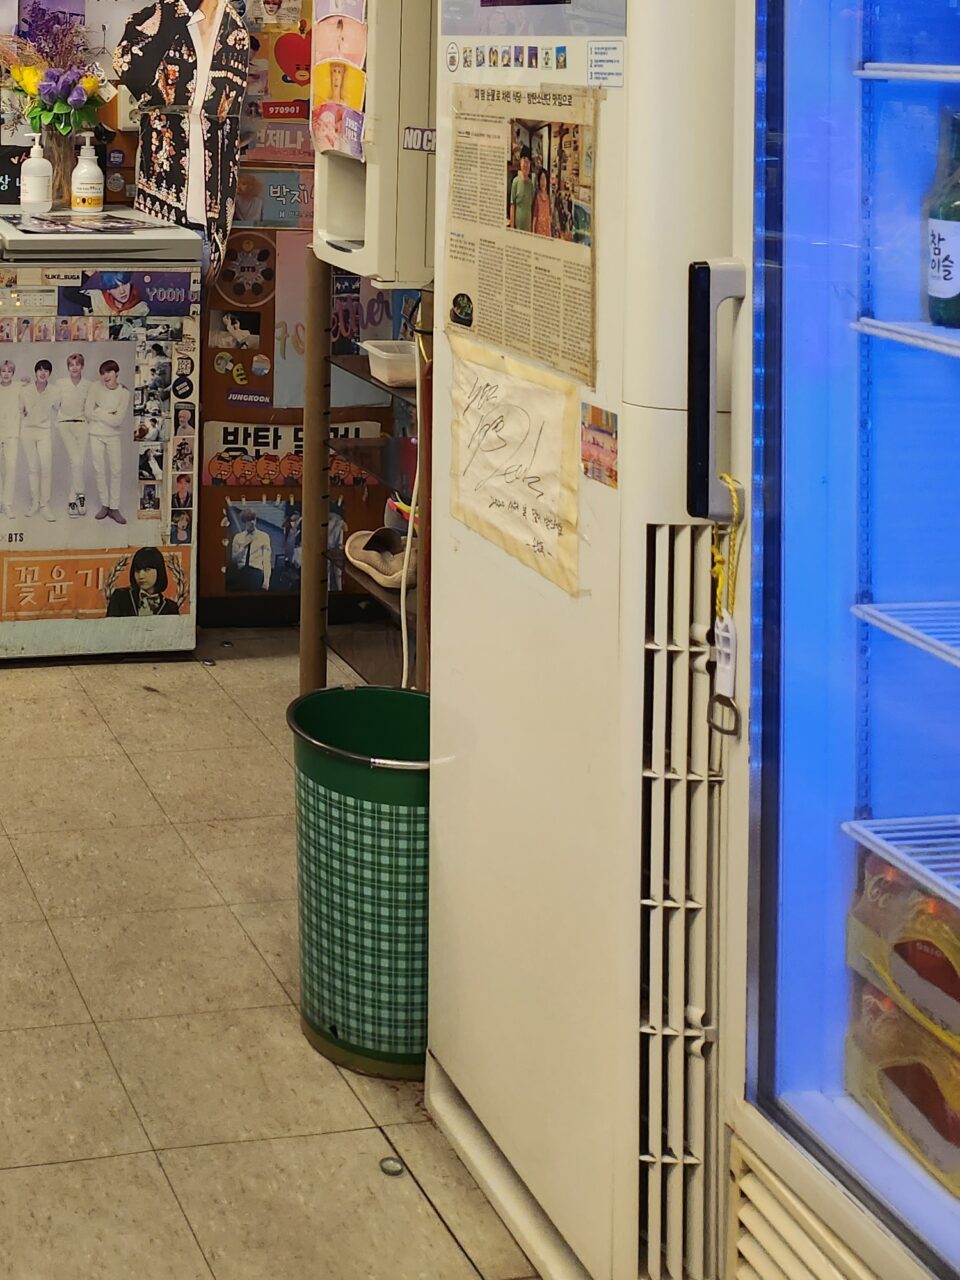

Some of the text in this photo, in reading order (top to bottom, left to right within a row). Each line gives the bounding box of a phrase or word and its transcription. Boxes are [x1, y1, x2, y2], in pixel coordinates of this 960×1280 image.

[268, 106, 300, 114] 970901
[403, 129, 422, 150] NO
[145, 286, 185, 303] YOON
[227, 392, 271, 404] JUNGKOOK
[8, 532, 24, 542] BTS
[14, 565, 105, 607] 꽃윤기
